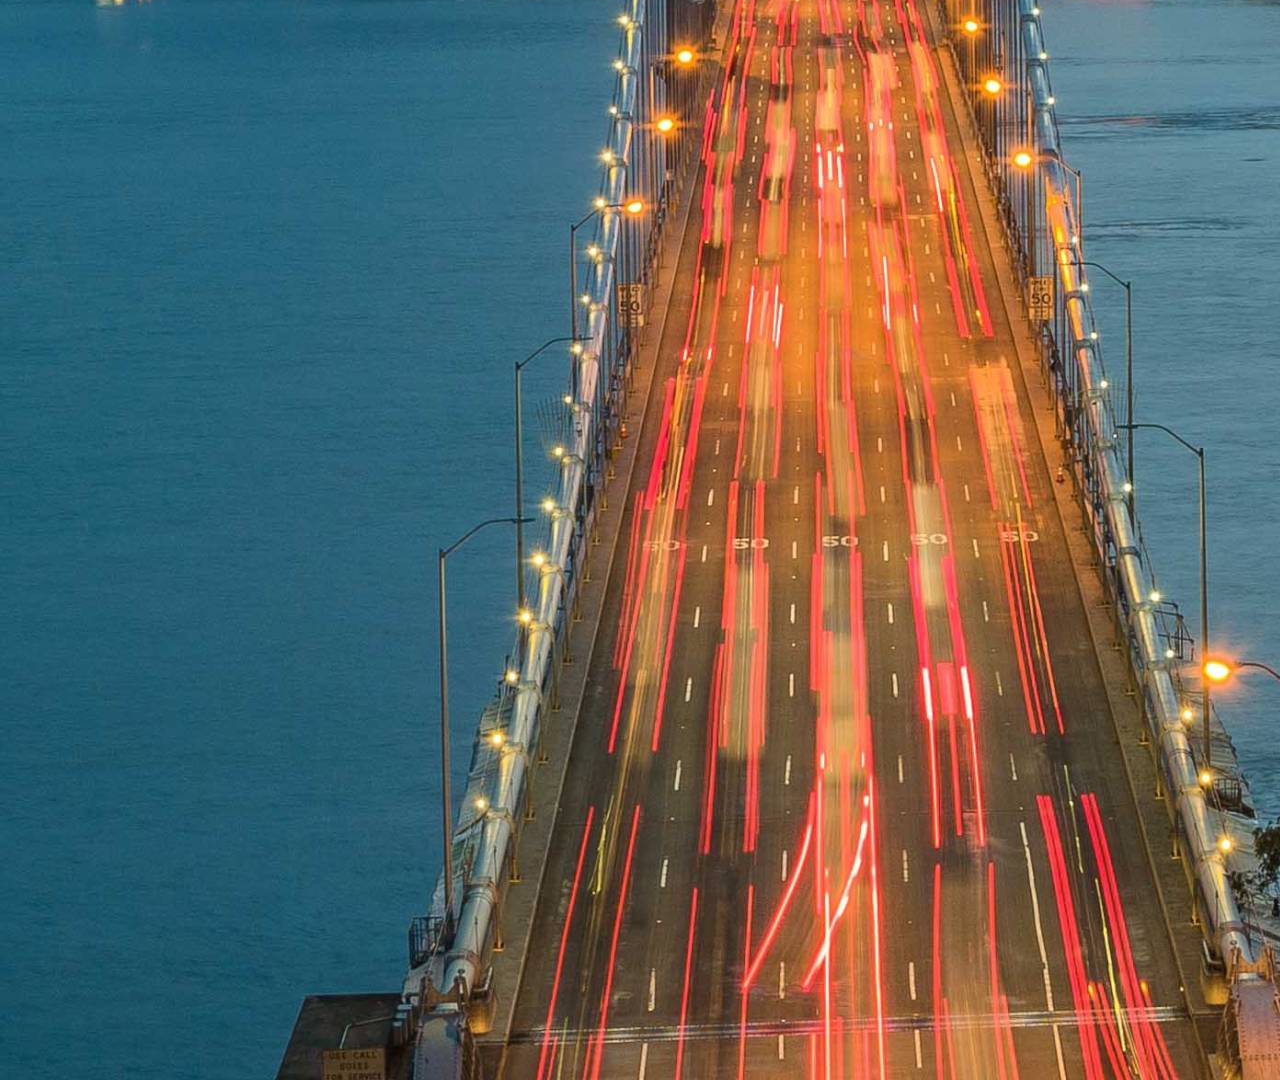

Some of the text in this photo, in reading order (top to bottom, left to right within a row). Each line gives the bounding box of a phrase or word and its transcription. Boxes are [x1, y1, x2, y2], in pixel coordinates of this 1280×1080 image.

[1032, 293, 1051, 304] 50
[621, 301, 640, 311] 50
[822, 536, 858, 547] 50
[911, 533, 948, 545] 50
[1002, 531, 1039, 542] 50
[732, 538, 769, 549] 50
[353, 1051, 378, 1059] CALL
